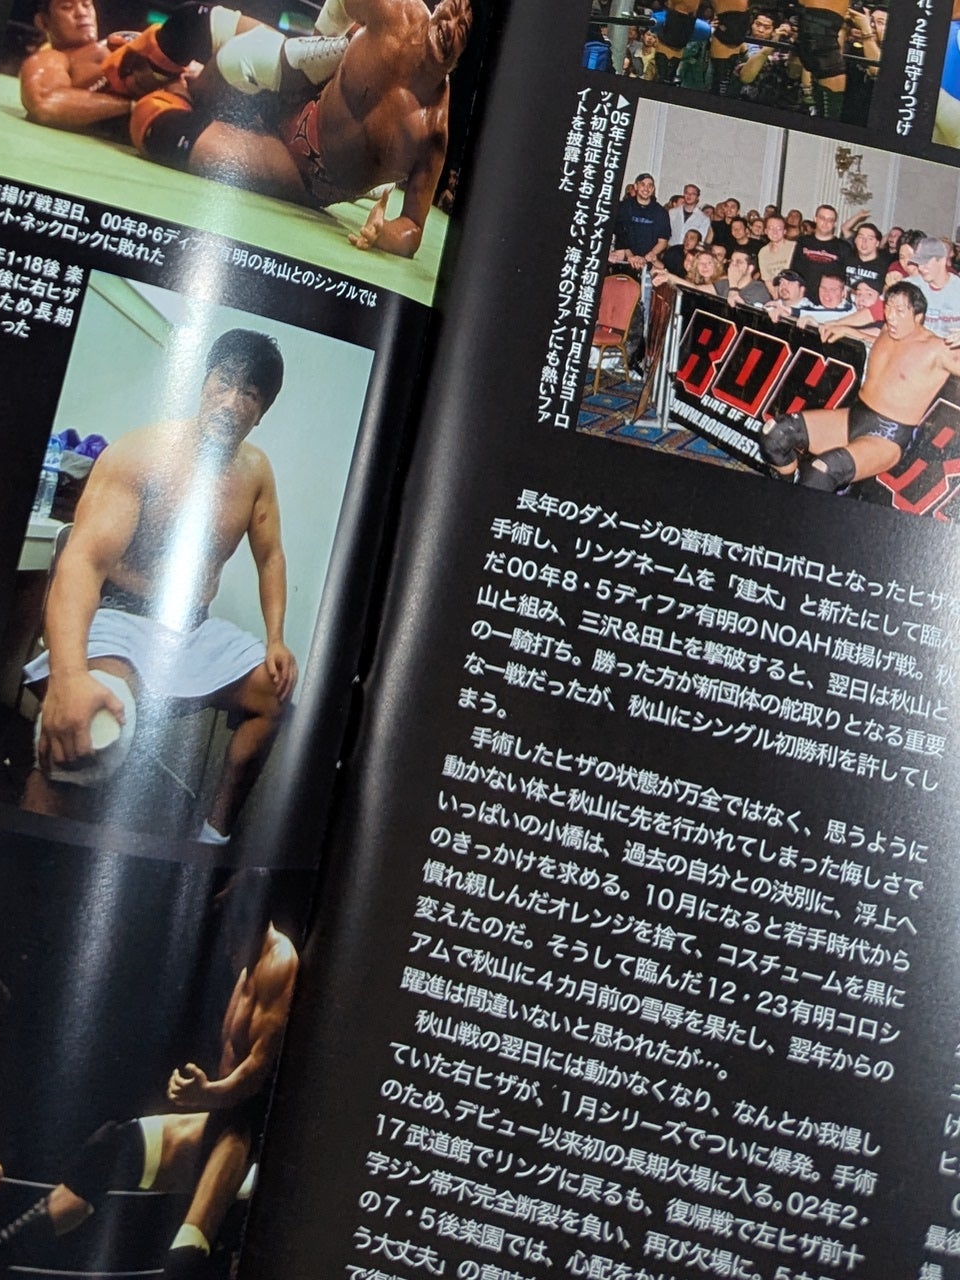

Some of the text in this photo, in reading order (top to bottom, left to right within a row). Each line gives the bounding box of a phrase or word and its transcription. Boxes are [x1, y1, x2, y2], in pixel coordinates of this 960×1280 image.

[558, 87, 592, 193] イトを披露した
[457, 686, 508, 719] まう。
